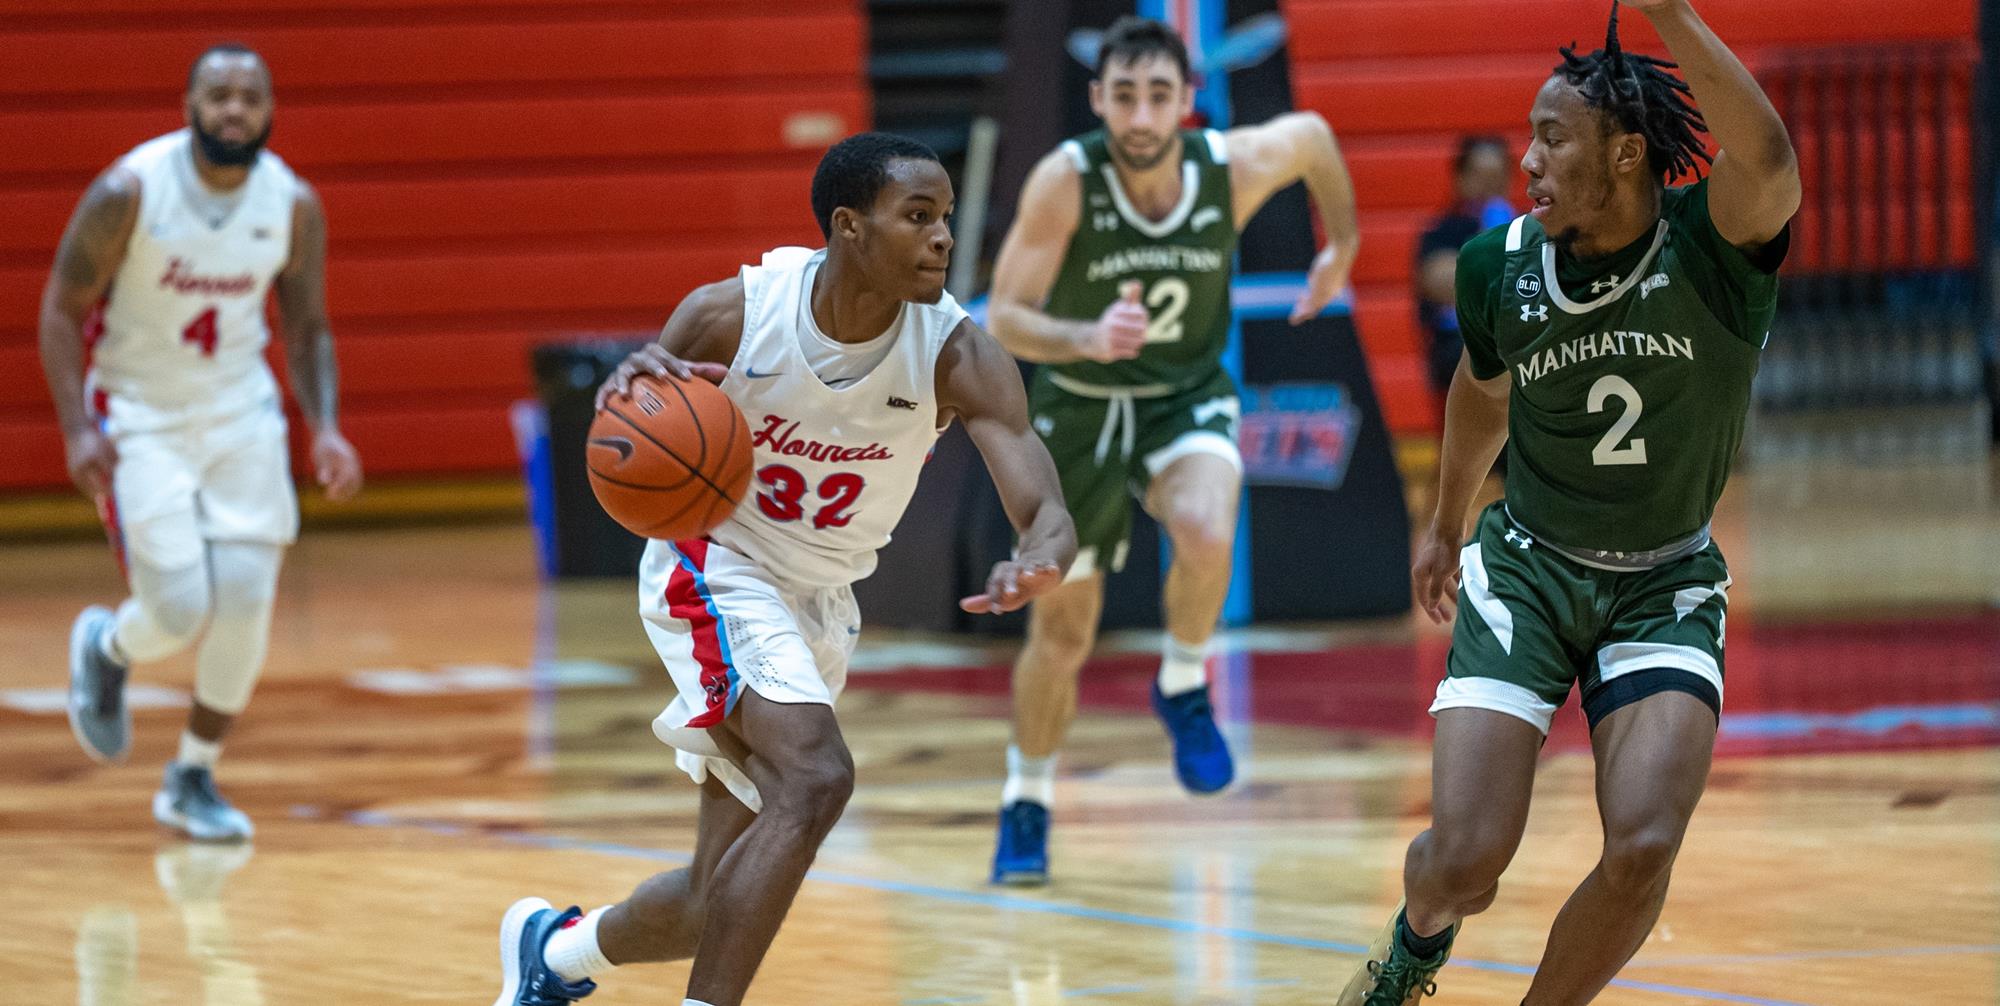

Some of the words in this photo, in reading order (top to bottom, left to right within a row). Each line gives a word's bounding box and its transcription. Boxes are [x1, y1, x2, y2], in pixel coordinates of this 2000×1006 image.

[1519, 279, 1539, 291] BLM
[182, 306, 218, 358] 4
[1517, 331, 1694, 387] MANHATTAN
[753, 415, 894, 462] Hornets
[1587, 375, 1647, 465] 2
[756, 464, 868, 530] 32
